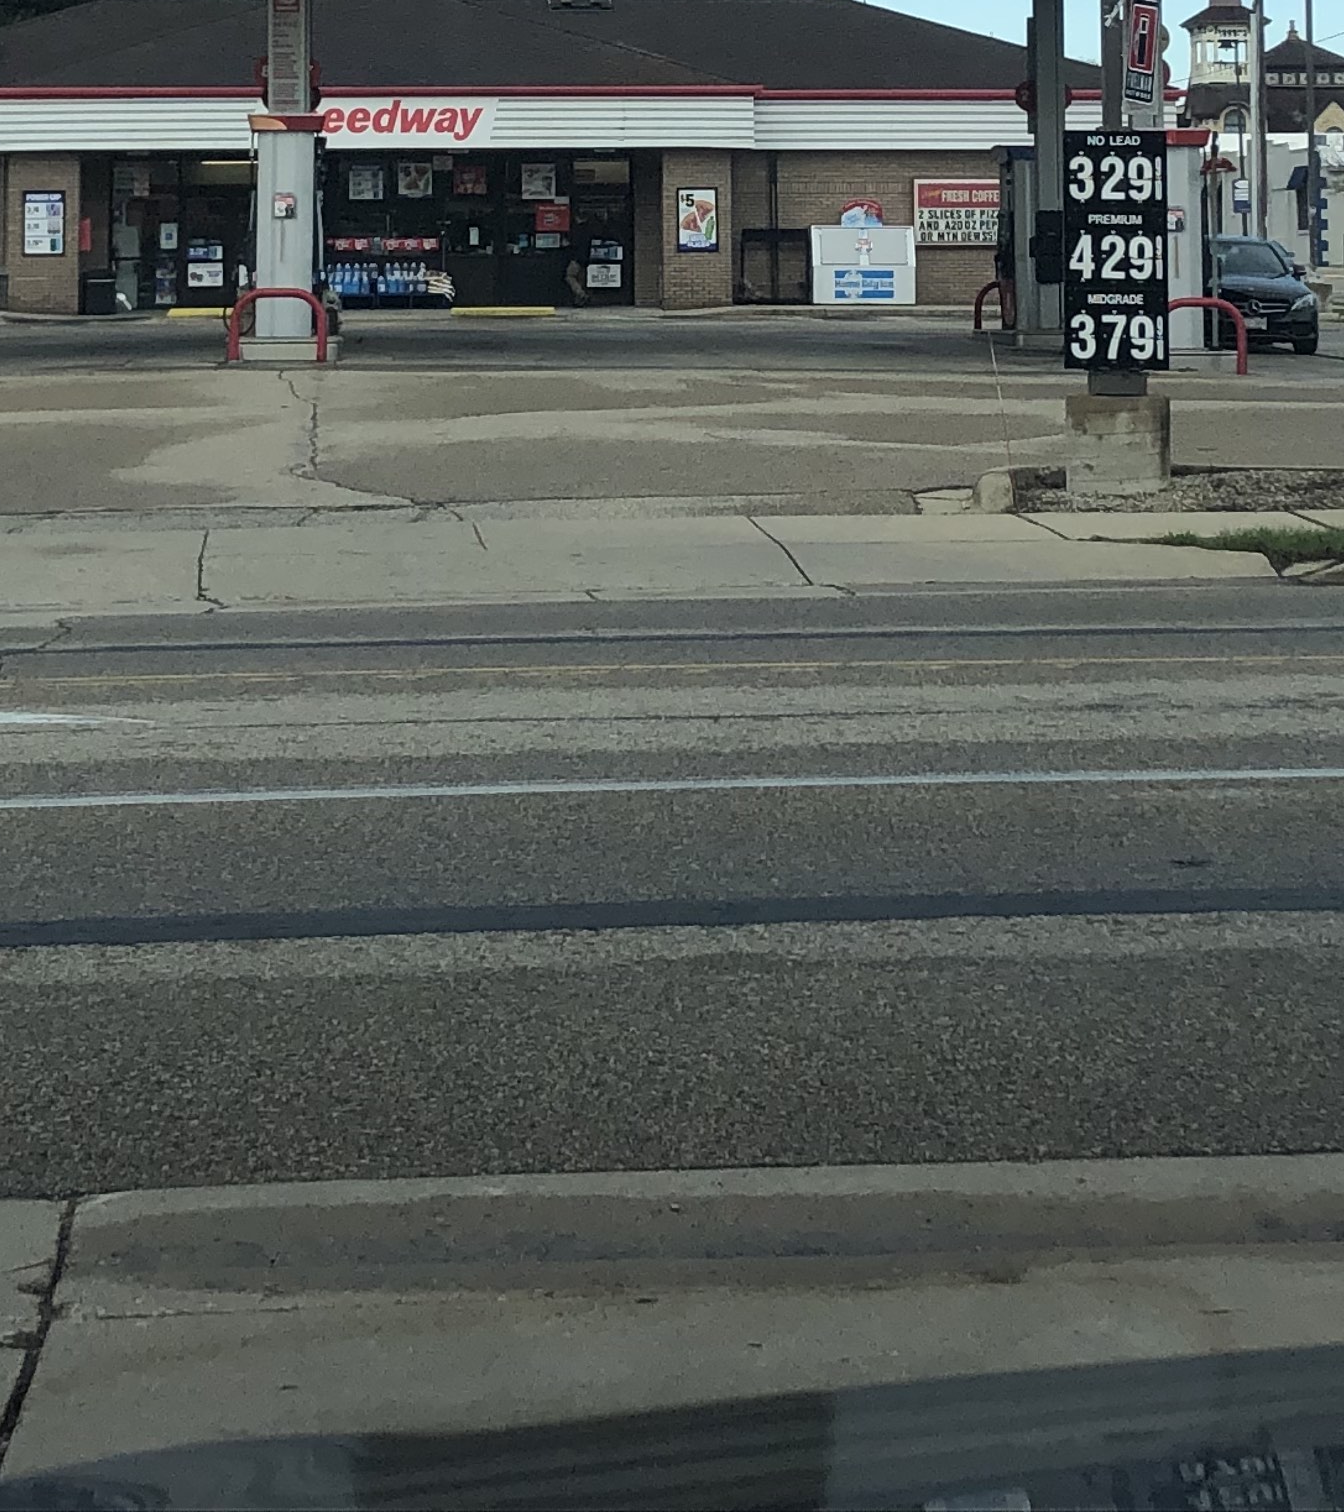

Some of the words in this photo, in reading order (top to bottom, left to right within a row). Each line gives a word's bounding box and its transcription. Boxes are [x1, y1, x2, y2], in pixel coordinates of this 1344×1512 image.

[322, 99, 484, 140] eedway
[1086, 135, 1105, 146] NO
[1109, 135, 1141, 146] LEAD
[681, 193, 695, 207] $5
[971, 190, 1000, 203] COFFE
[918, 209, 924, 219] 2
[927, 209, 962, 220] SLICES
[964, 209, 977, 220] OF
[979, 209, 1000, 220] PIZ
[1088, 214, 1143, 225] PREMIUM
[918, 220, 940, 231] AND
[979, 220, 998, 231] PEP
[920, 231, 933, 242] OR
[937, 231, 959, 242] MTN
[1087, 293, 1145, 305] MIDGRADE
